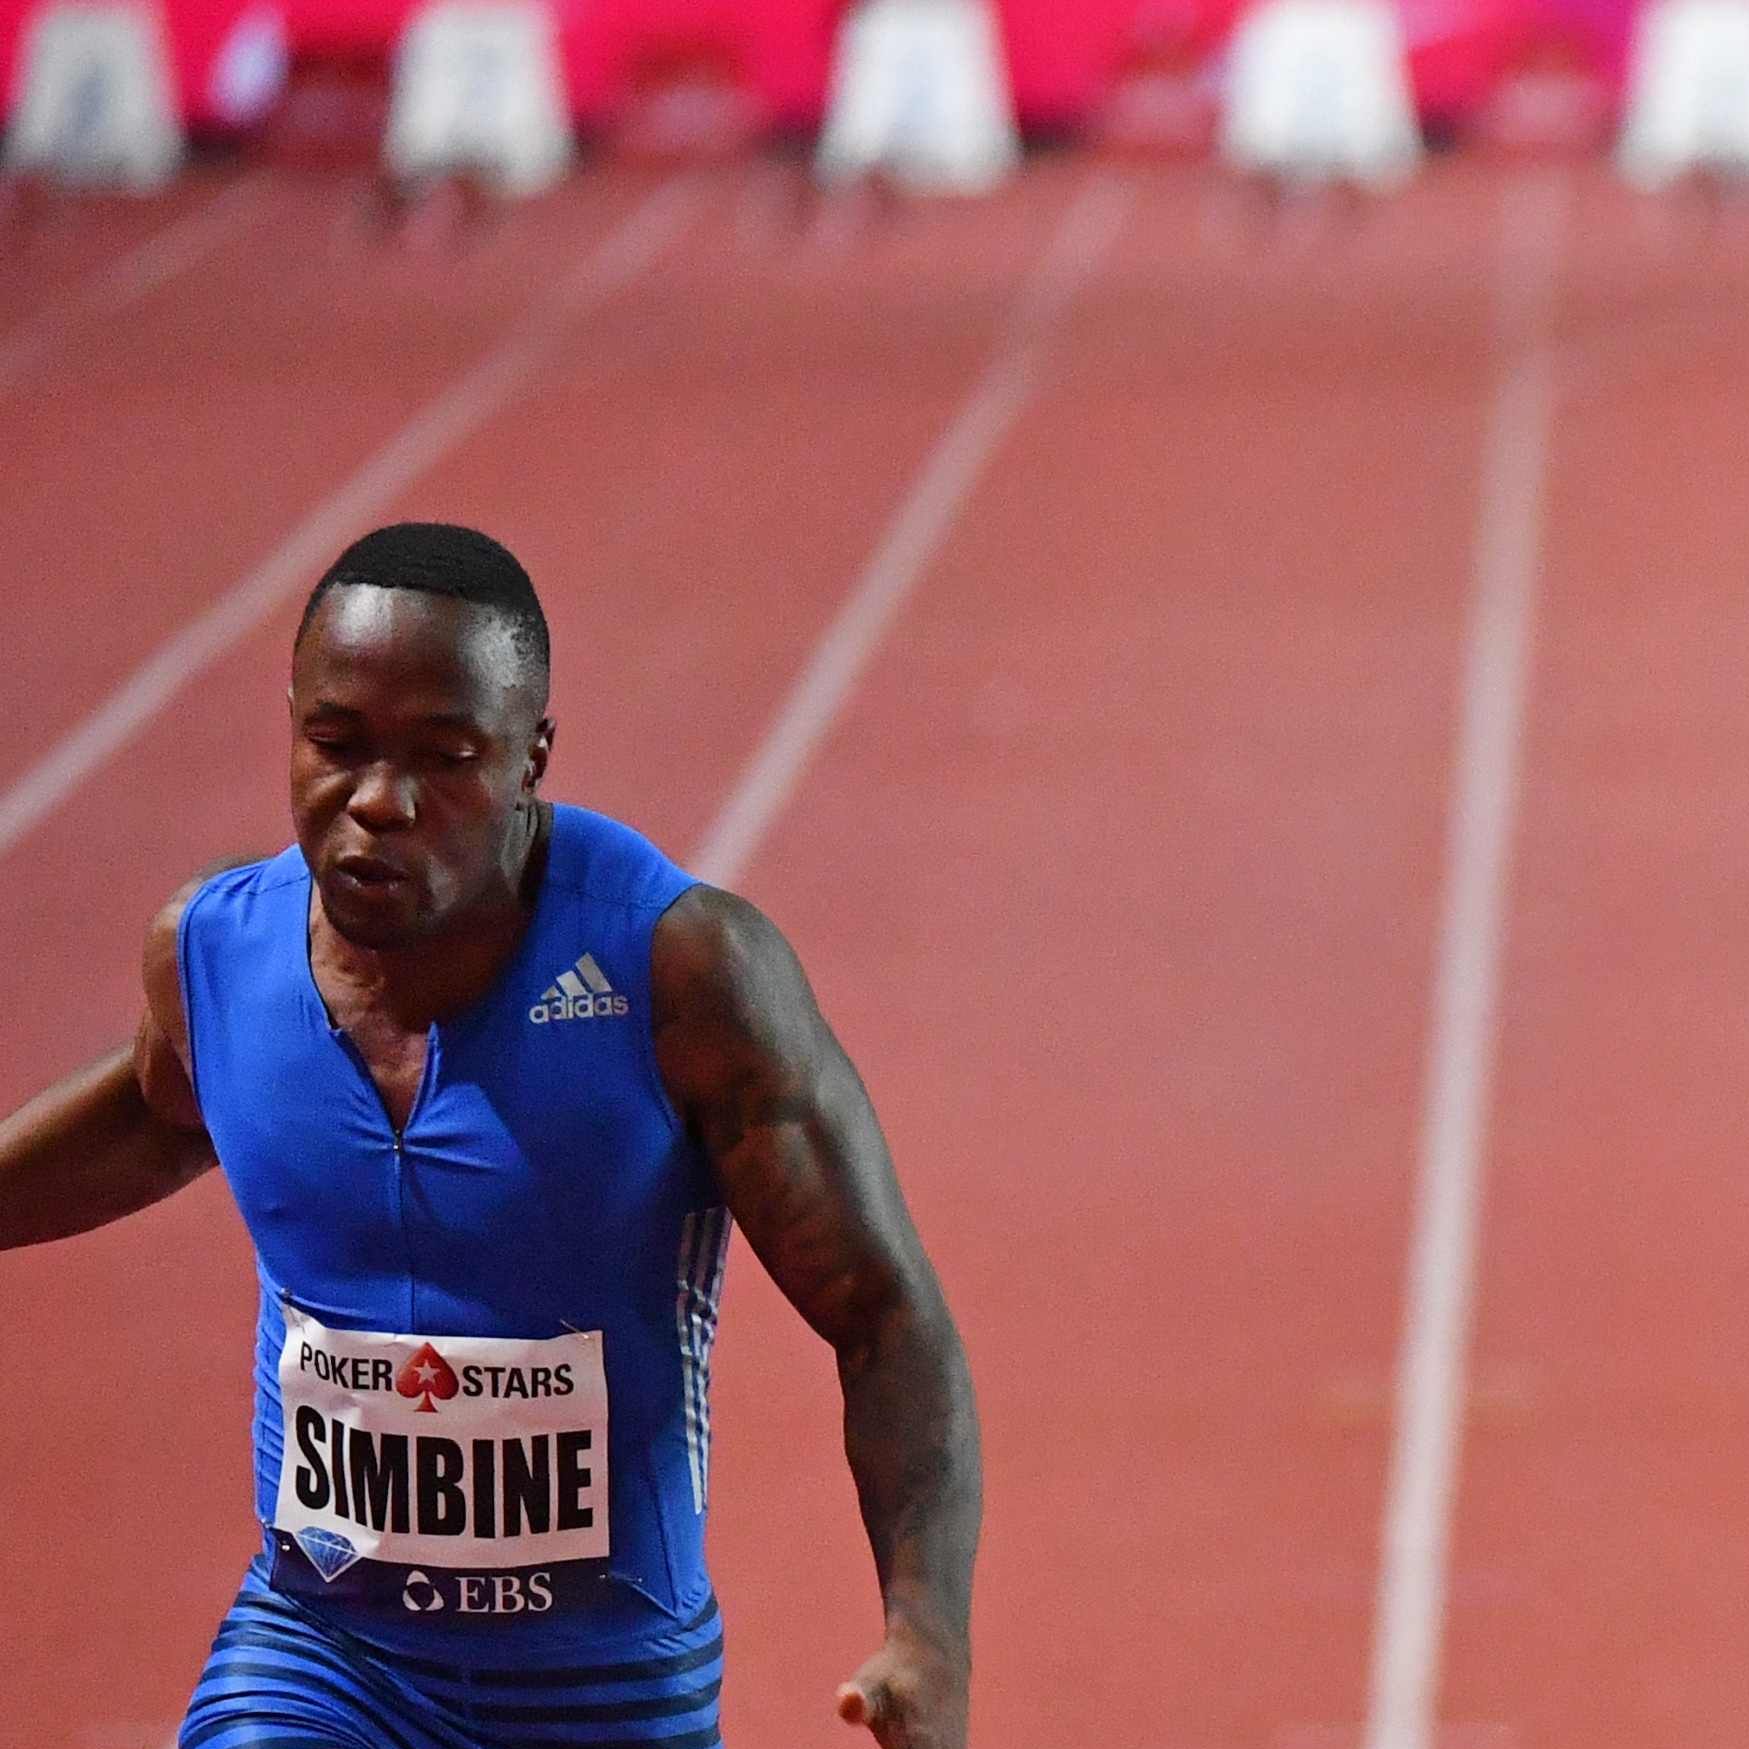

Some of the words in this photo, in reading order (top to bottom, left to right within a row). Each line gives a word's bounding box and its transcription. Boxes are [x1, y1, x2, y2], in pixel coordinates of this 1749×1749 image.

[528, 994, 629, 1024] adidas
[299, 1341, 393, 1392] POKER
[461, 1363, 575, 1399] STARS
[294, 1404, 594, 1540] SIMBINE
[454, 1571, 554, 1614] EBS
